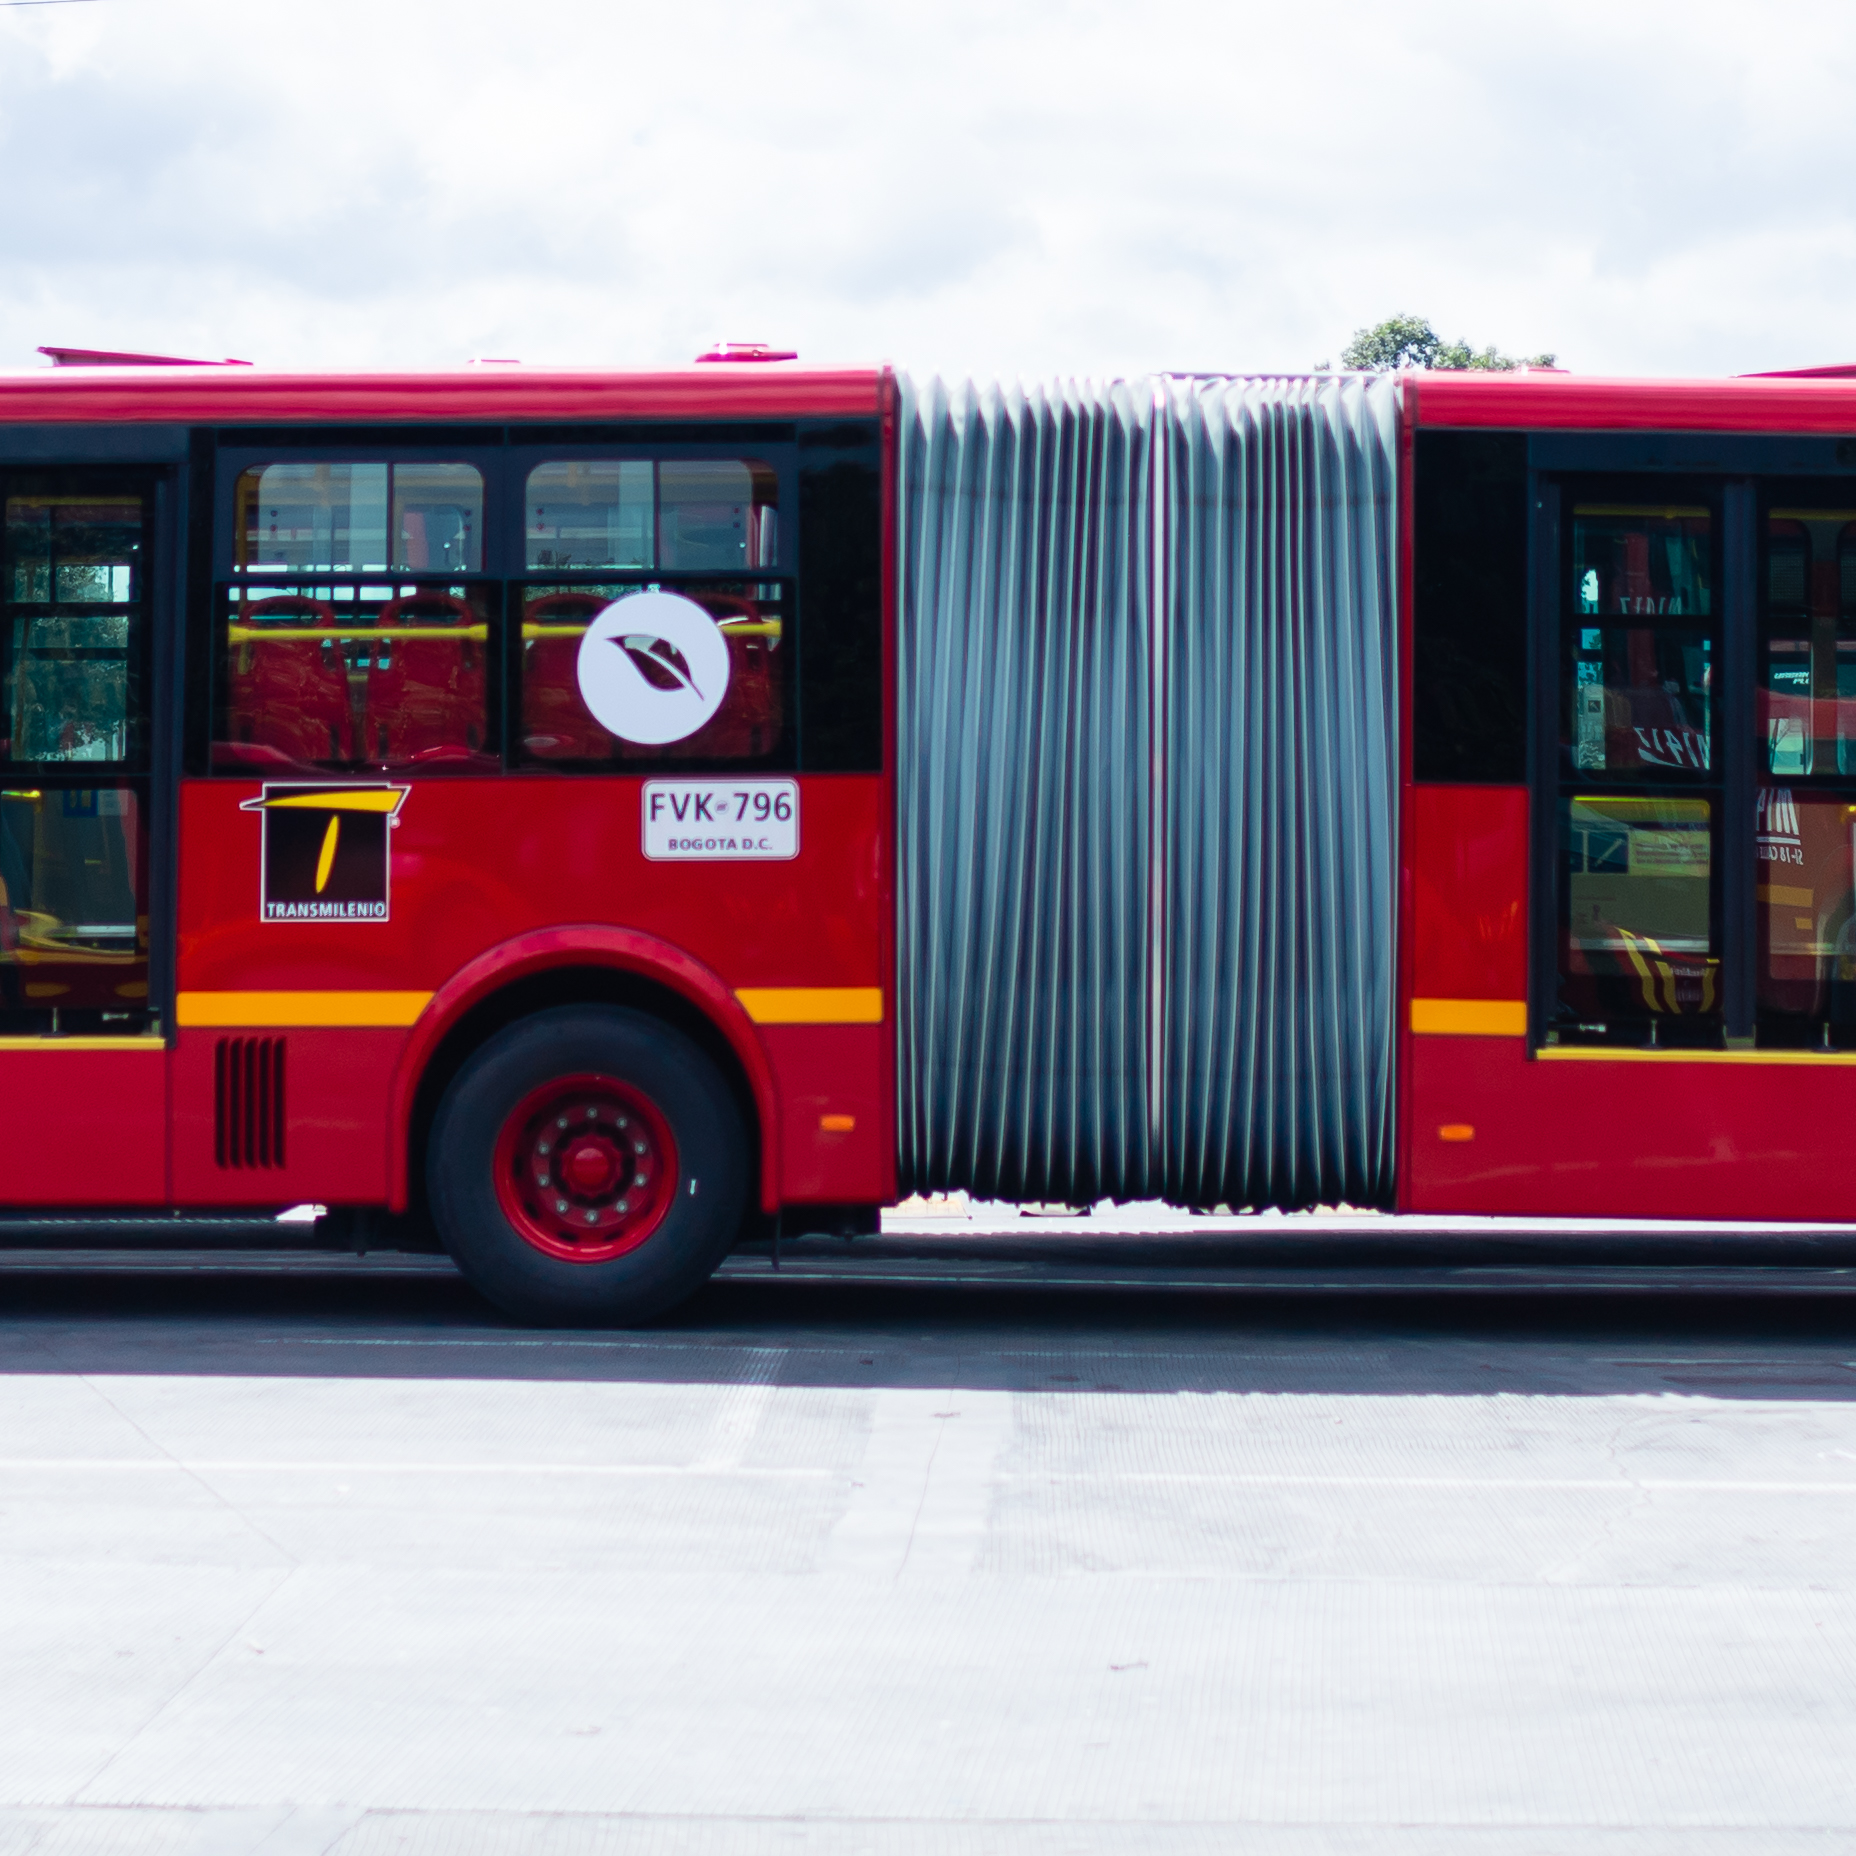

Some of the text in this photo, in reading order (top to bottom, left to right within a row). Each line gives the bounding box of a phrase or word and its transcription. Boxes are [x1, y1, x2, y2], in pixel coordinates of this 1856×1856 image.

[650, 793, 792, 822] FVK 796
[668, 838, 773, 851] BOGOTA D.C.
[267, 902, 386, 918] TRANSMILENIO
